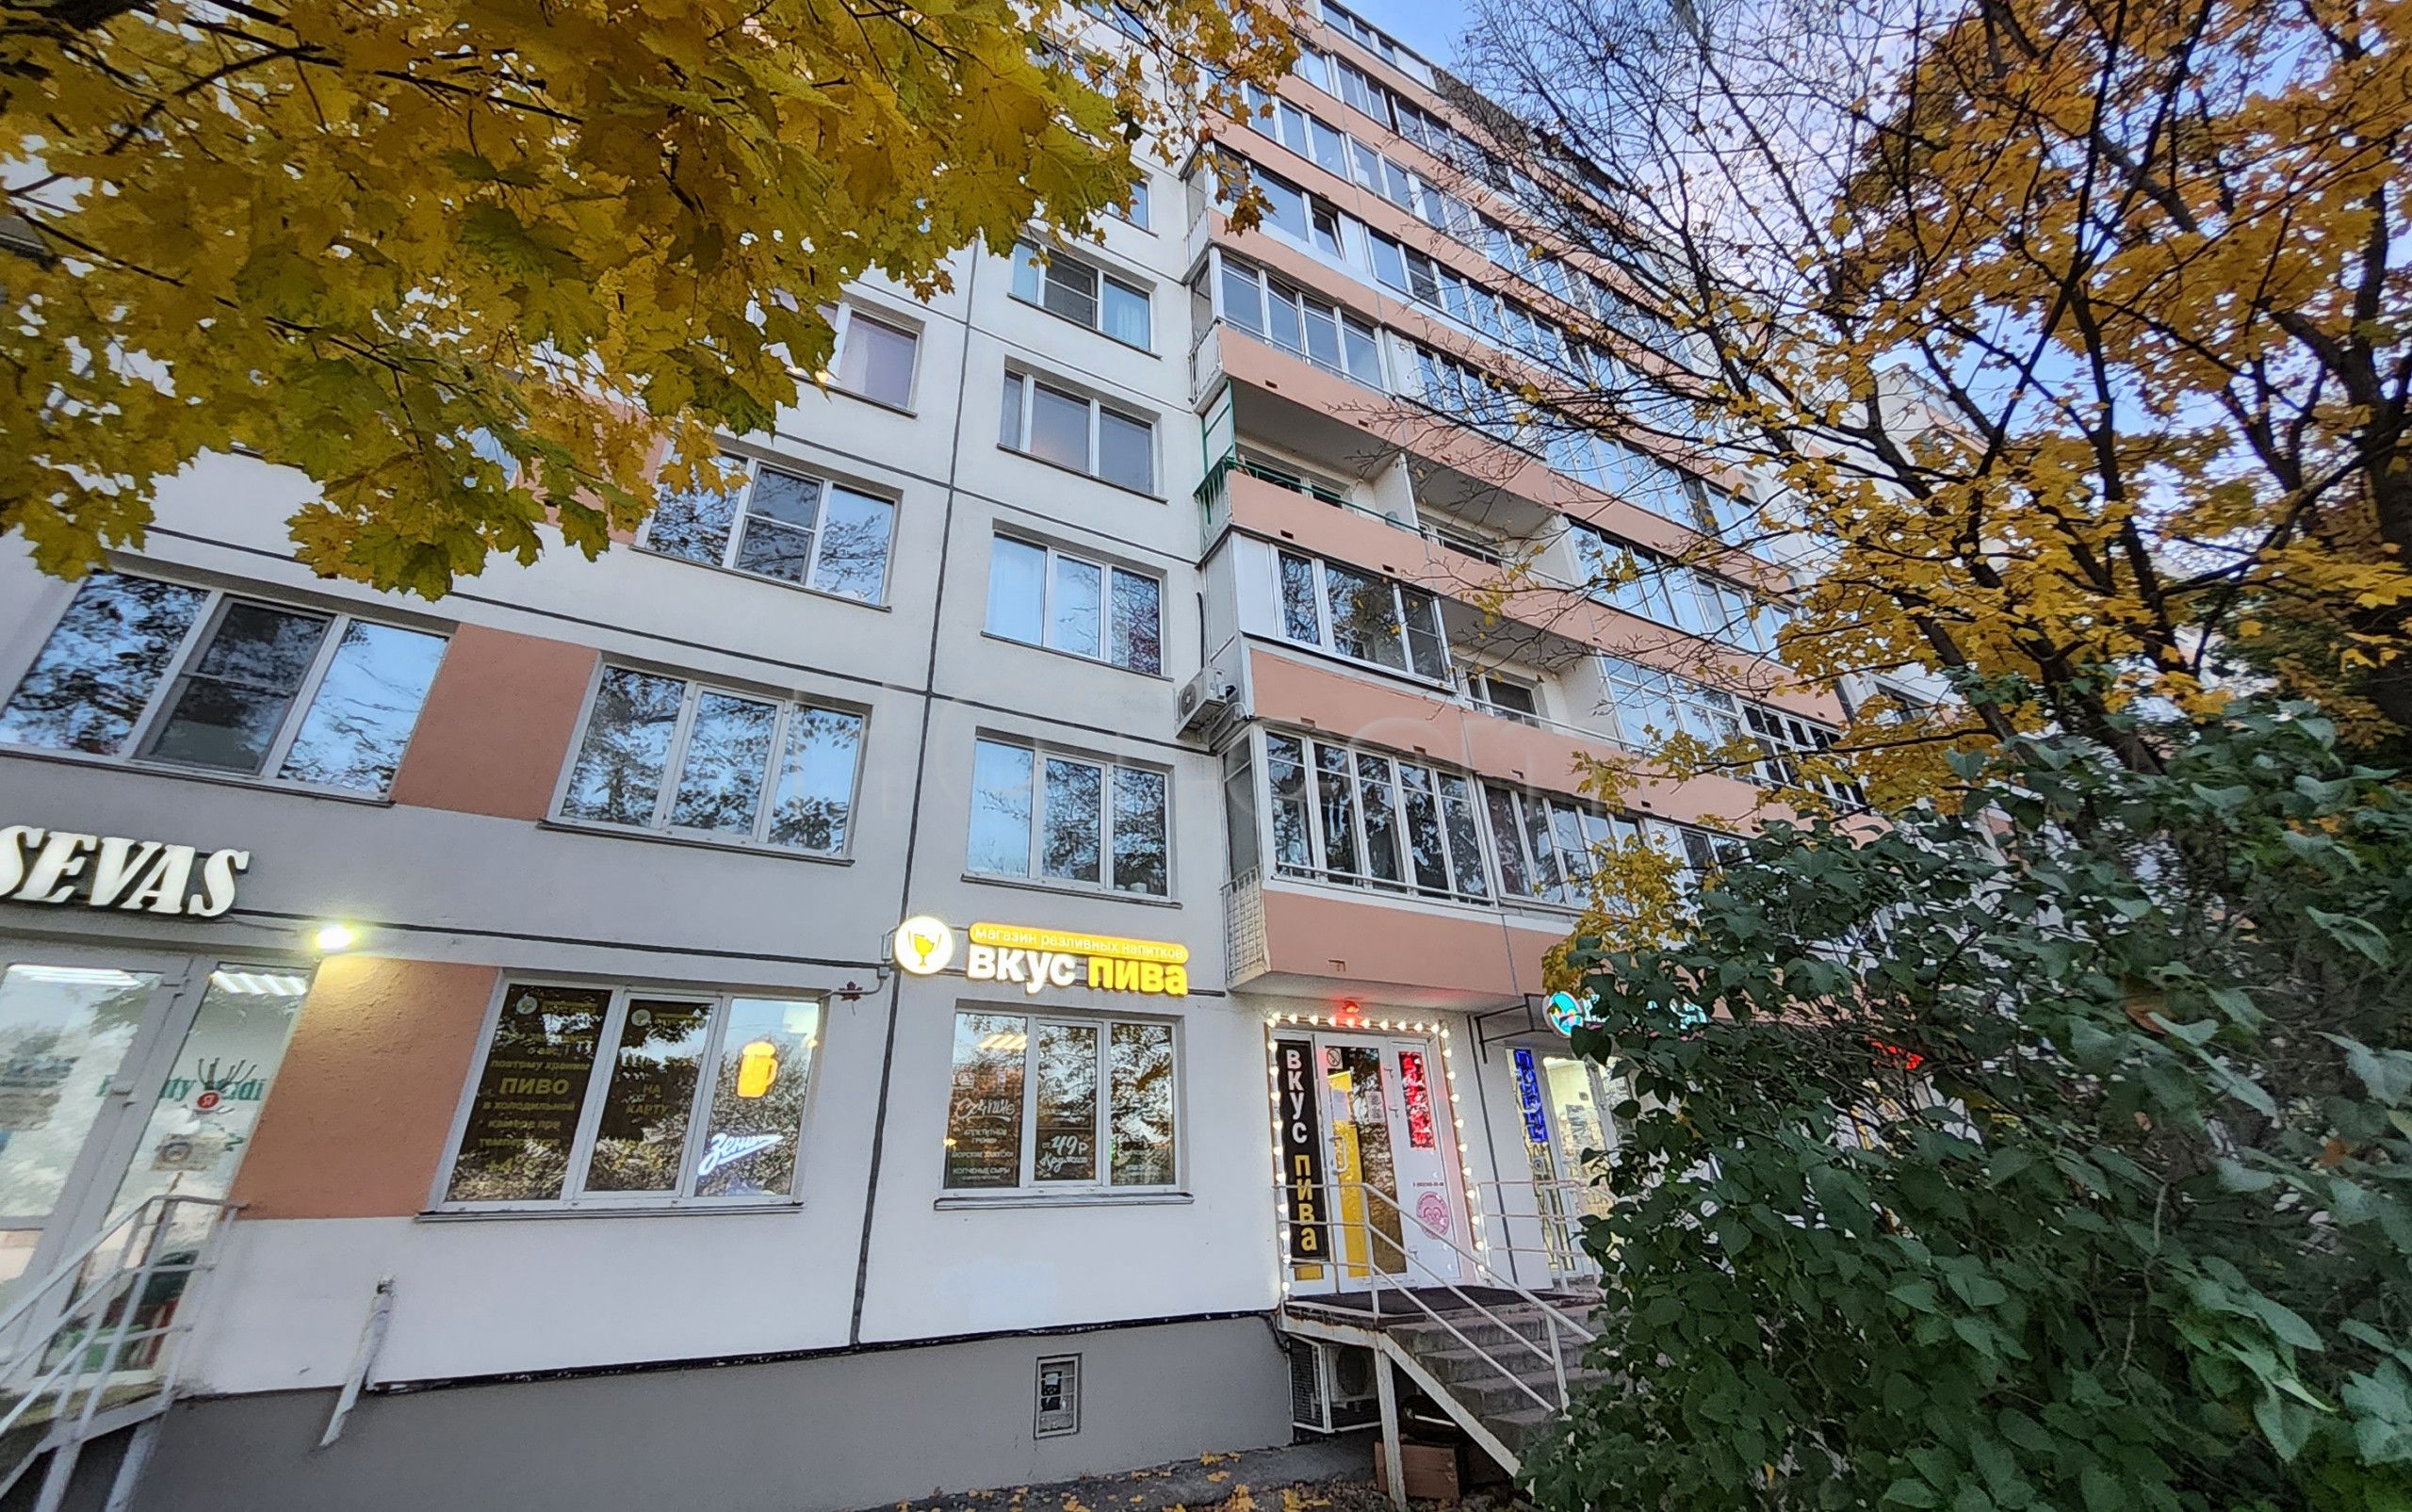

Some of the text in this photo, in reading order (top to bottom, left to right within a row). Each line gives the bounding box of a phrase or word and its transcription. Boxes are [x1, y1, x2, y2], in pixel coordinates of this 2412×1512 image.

[0, 824, 250, 918] SEVAS
[974, 926, 1184, 960] магазин разливных напитков
[499, 1077, 570, 1095] ПИВО
